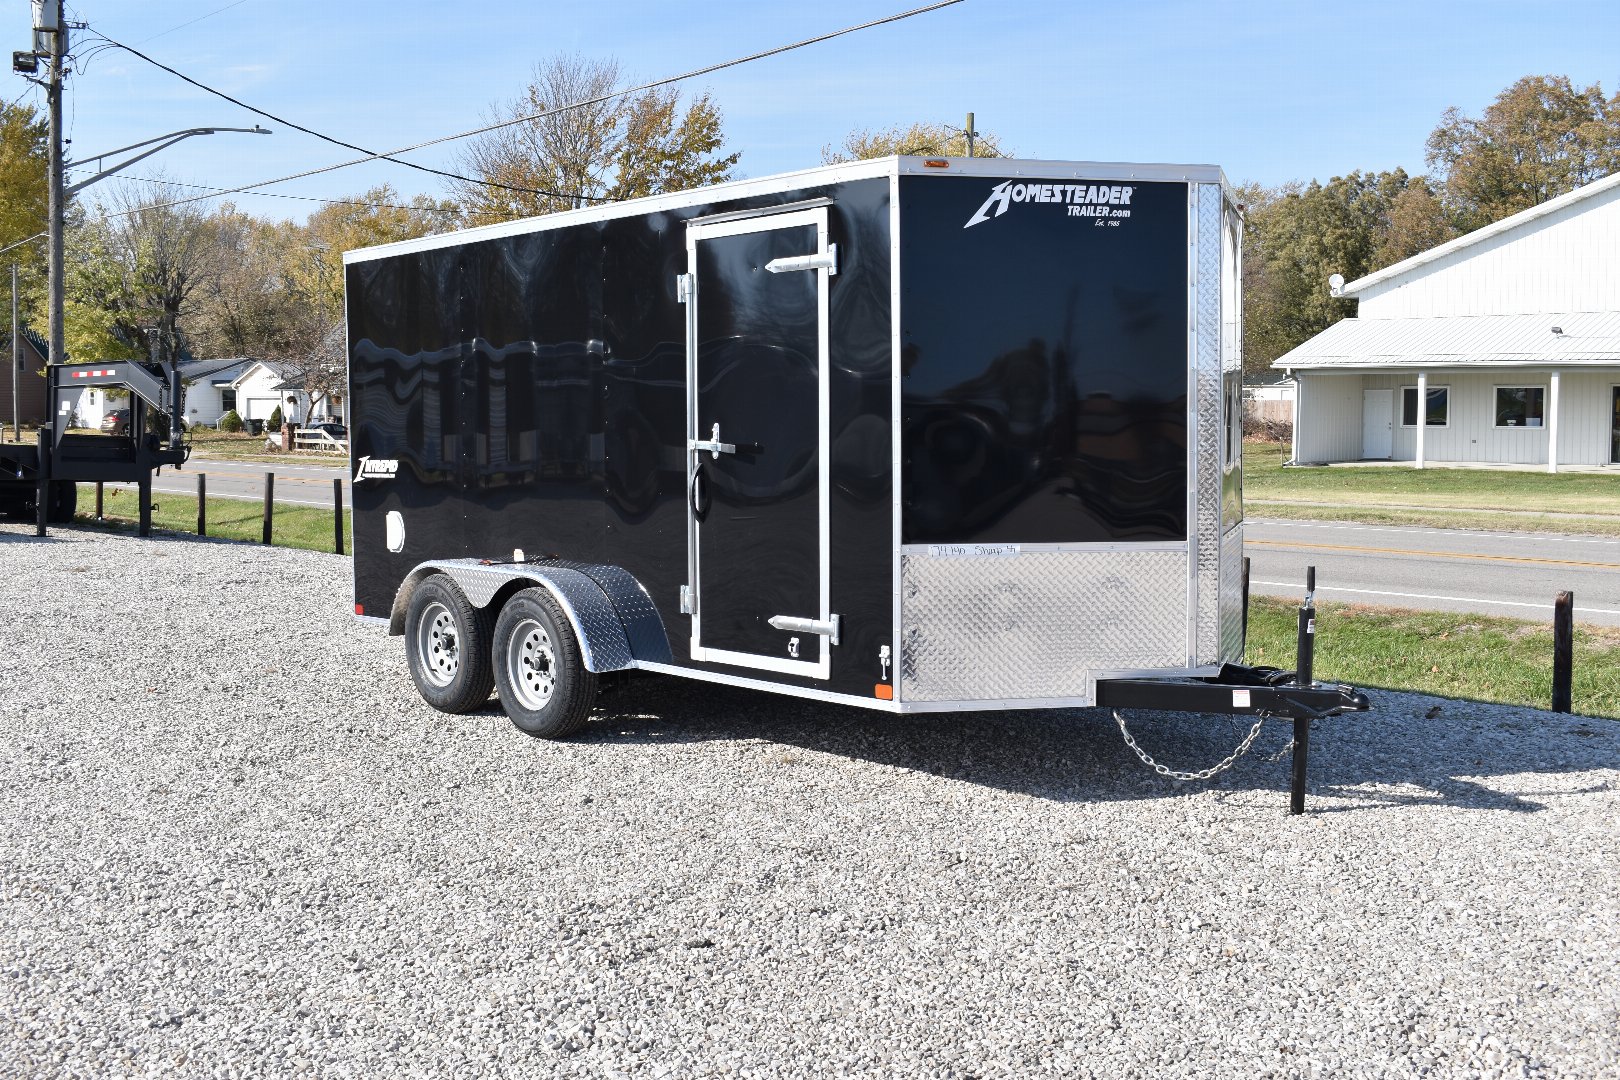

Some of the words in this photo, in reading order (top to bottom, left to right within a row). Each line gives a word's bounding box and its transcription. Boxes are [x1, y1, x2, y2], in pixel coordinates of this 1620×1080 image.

[964, 180, 1133, 228] HOMESTEADER
[1067, 205, 1131, 218] TRAILER.com
[353, 455, 399, 483] INTREPID
